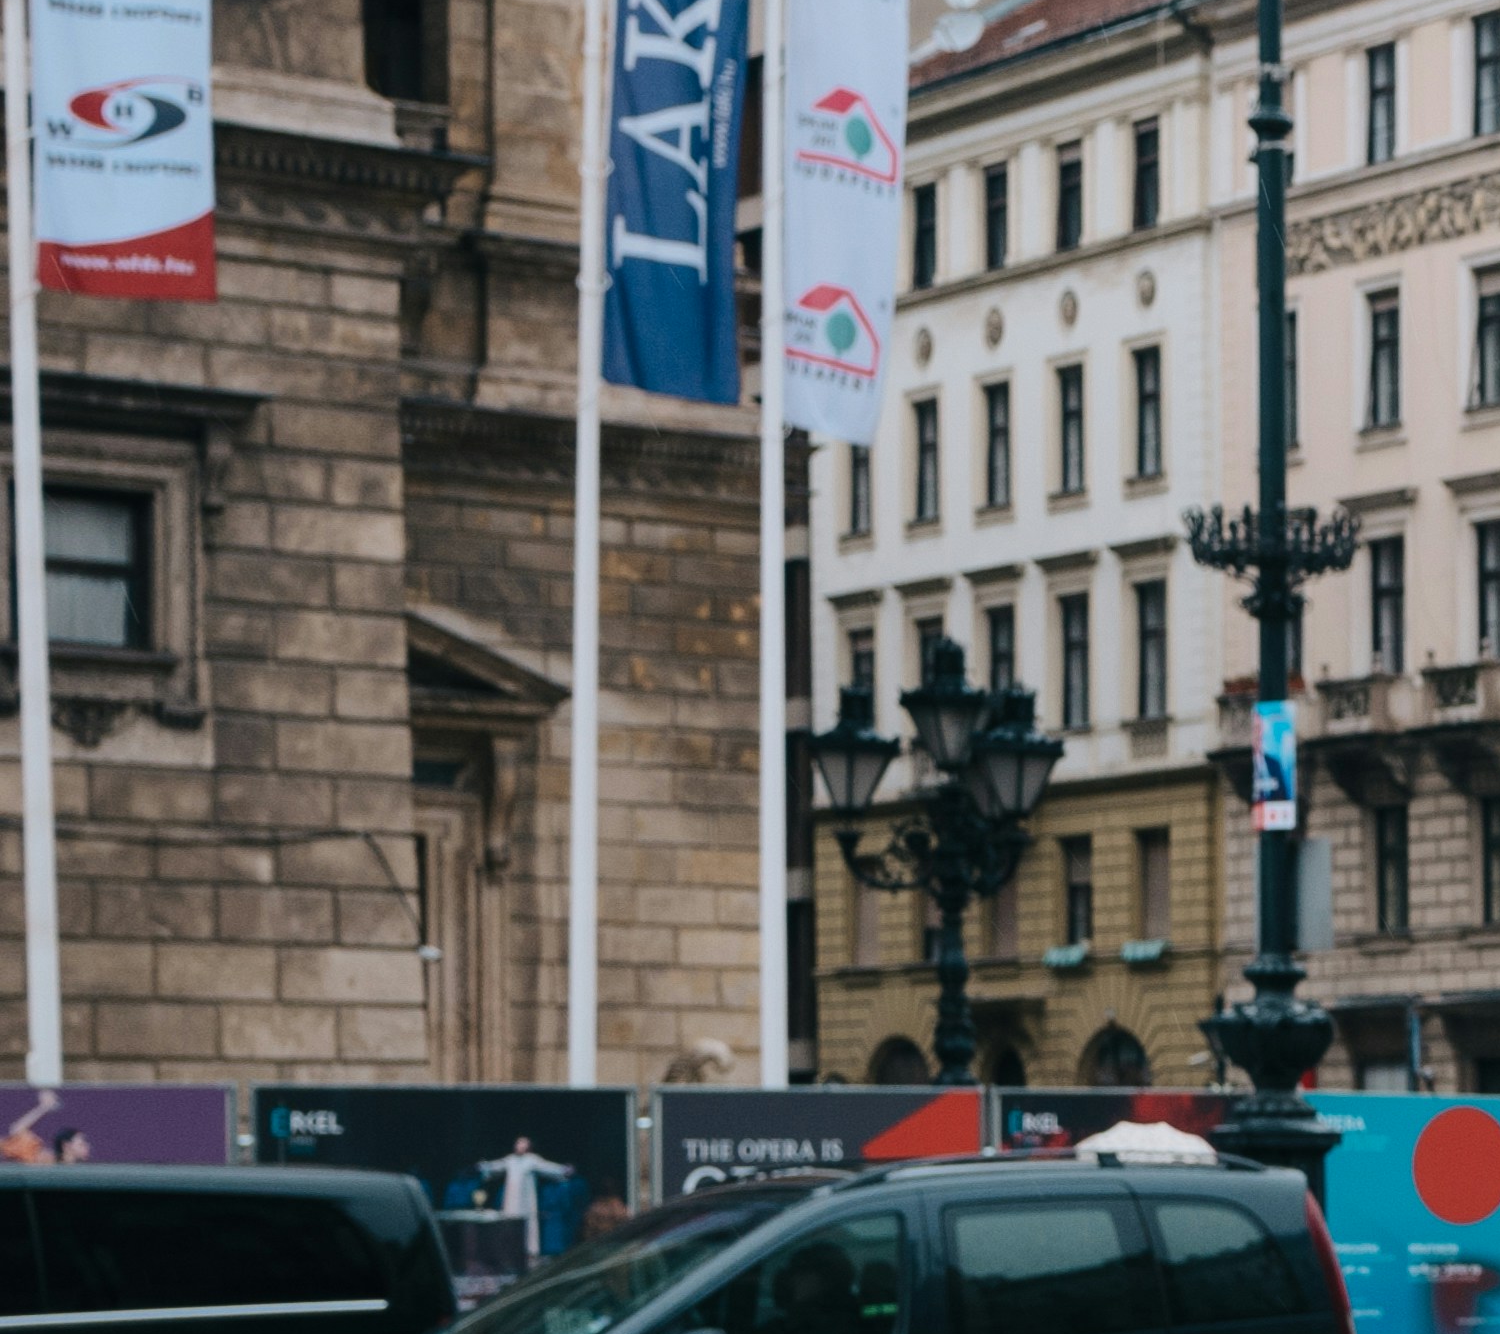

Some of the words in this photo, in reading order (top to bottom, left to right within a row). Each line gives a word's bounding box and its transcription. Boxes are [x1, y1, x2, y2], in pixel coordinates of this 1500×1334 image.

[682, 1138, 735, 1163] THE
[737, 1138, 817, 1164] OPERA
[821, 1138, 844, 1163] IS
